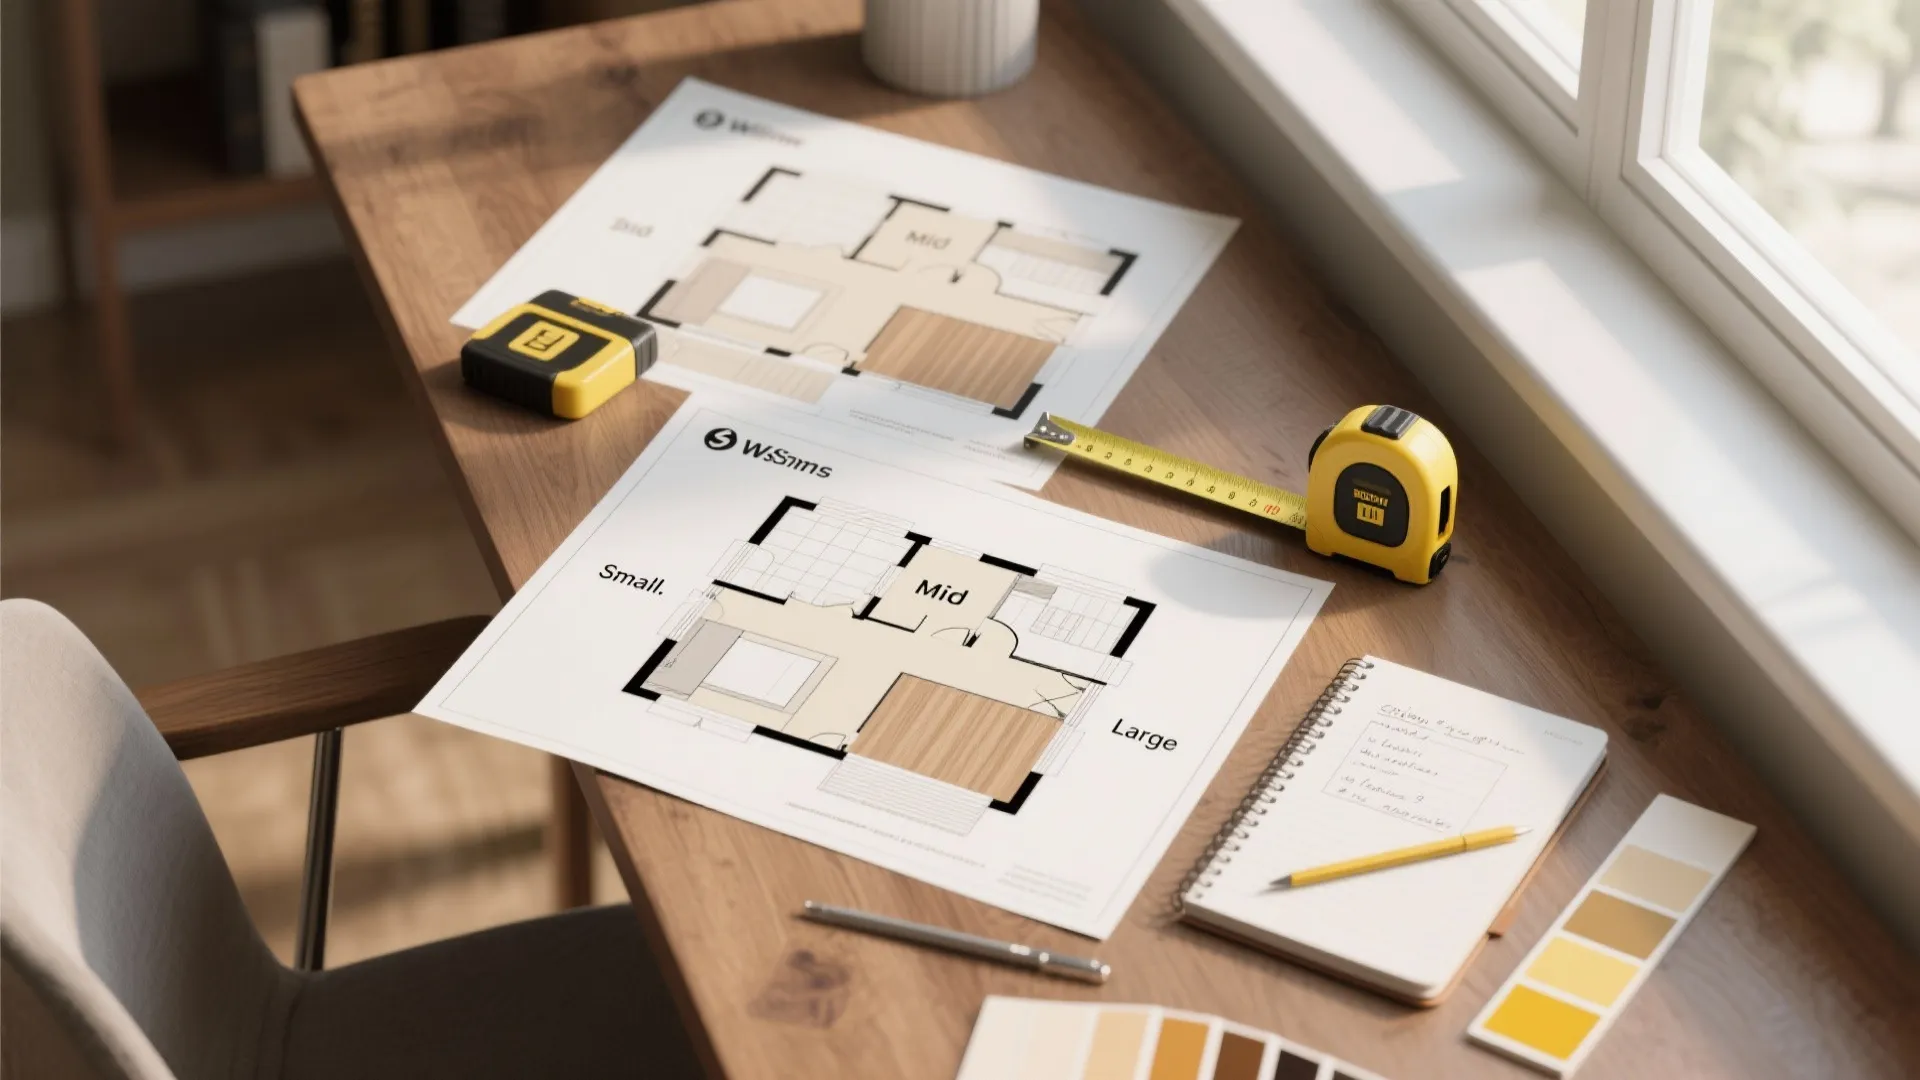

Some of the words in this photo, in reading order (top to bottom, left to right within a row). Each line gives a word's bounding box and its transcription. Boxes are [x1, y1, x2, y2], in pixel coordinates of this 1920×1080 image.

[598, 563, 665, 596] Small.
[914, 579, 969, 606] Mid
[1111, 718, 1178, 751] Large
